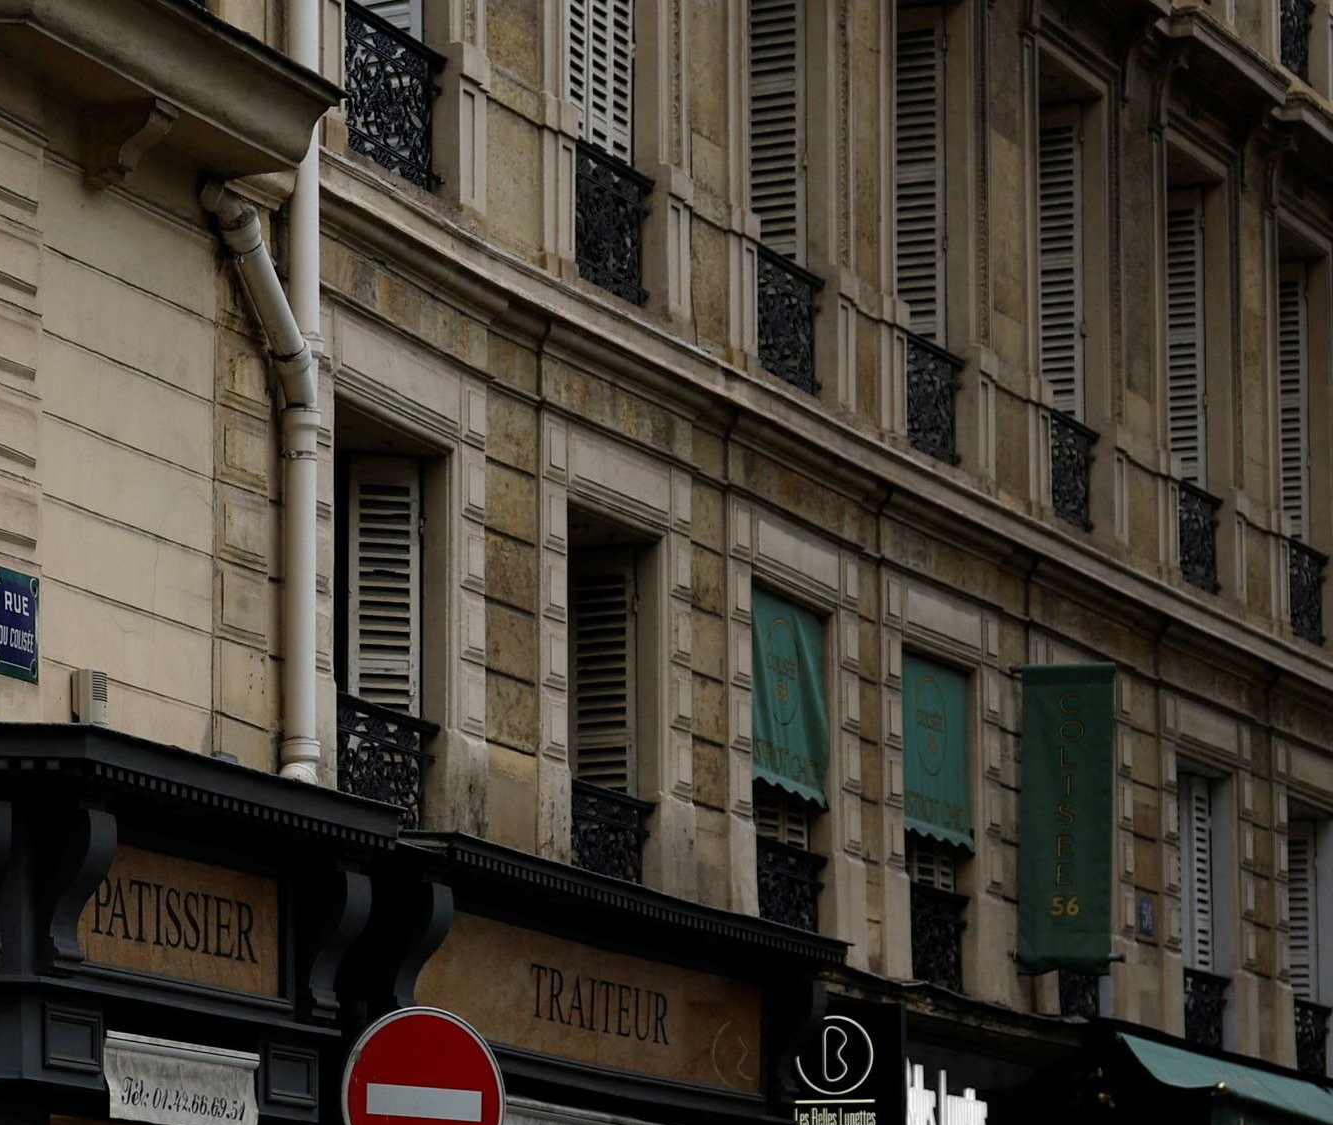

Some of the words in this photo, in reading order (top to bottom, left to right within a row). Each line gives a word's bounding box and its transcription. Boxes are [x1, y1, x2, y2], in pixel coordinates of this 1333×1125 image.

[4, 590, 30, 617] RUE
[9, 627, 35, 654] COLISÉE
[1051, 897, 1080, 916] 56
[91, 877, 259, 965] PATISSIER
[531, 963, 670, 1045] TRAITEUR
